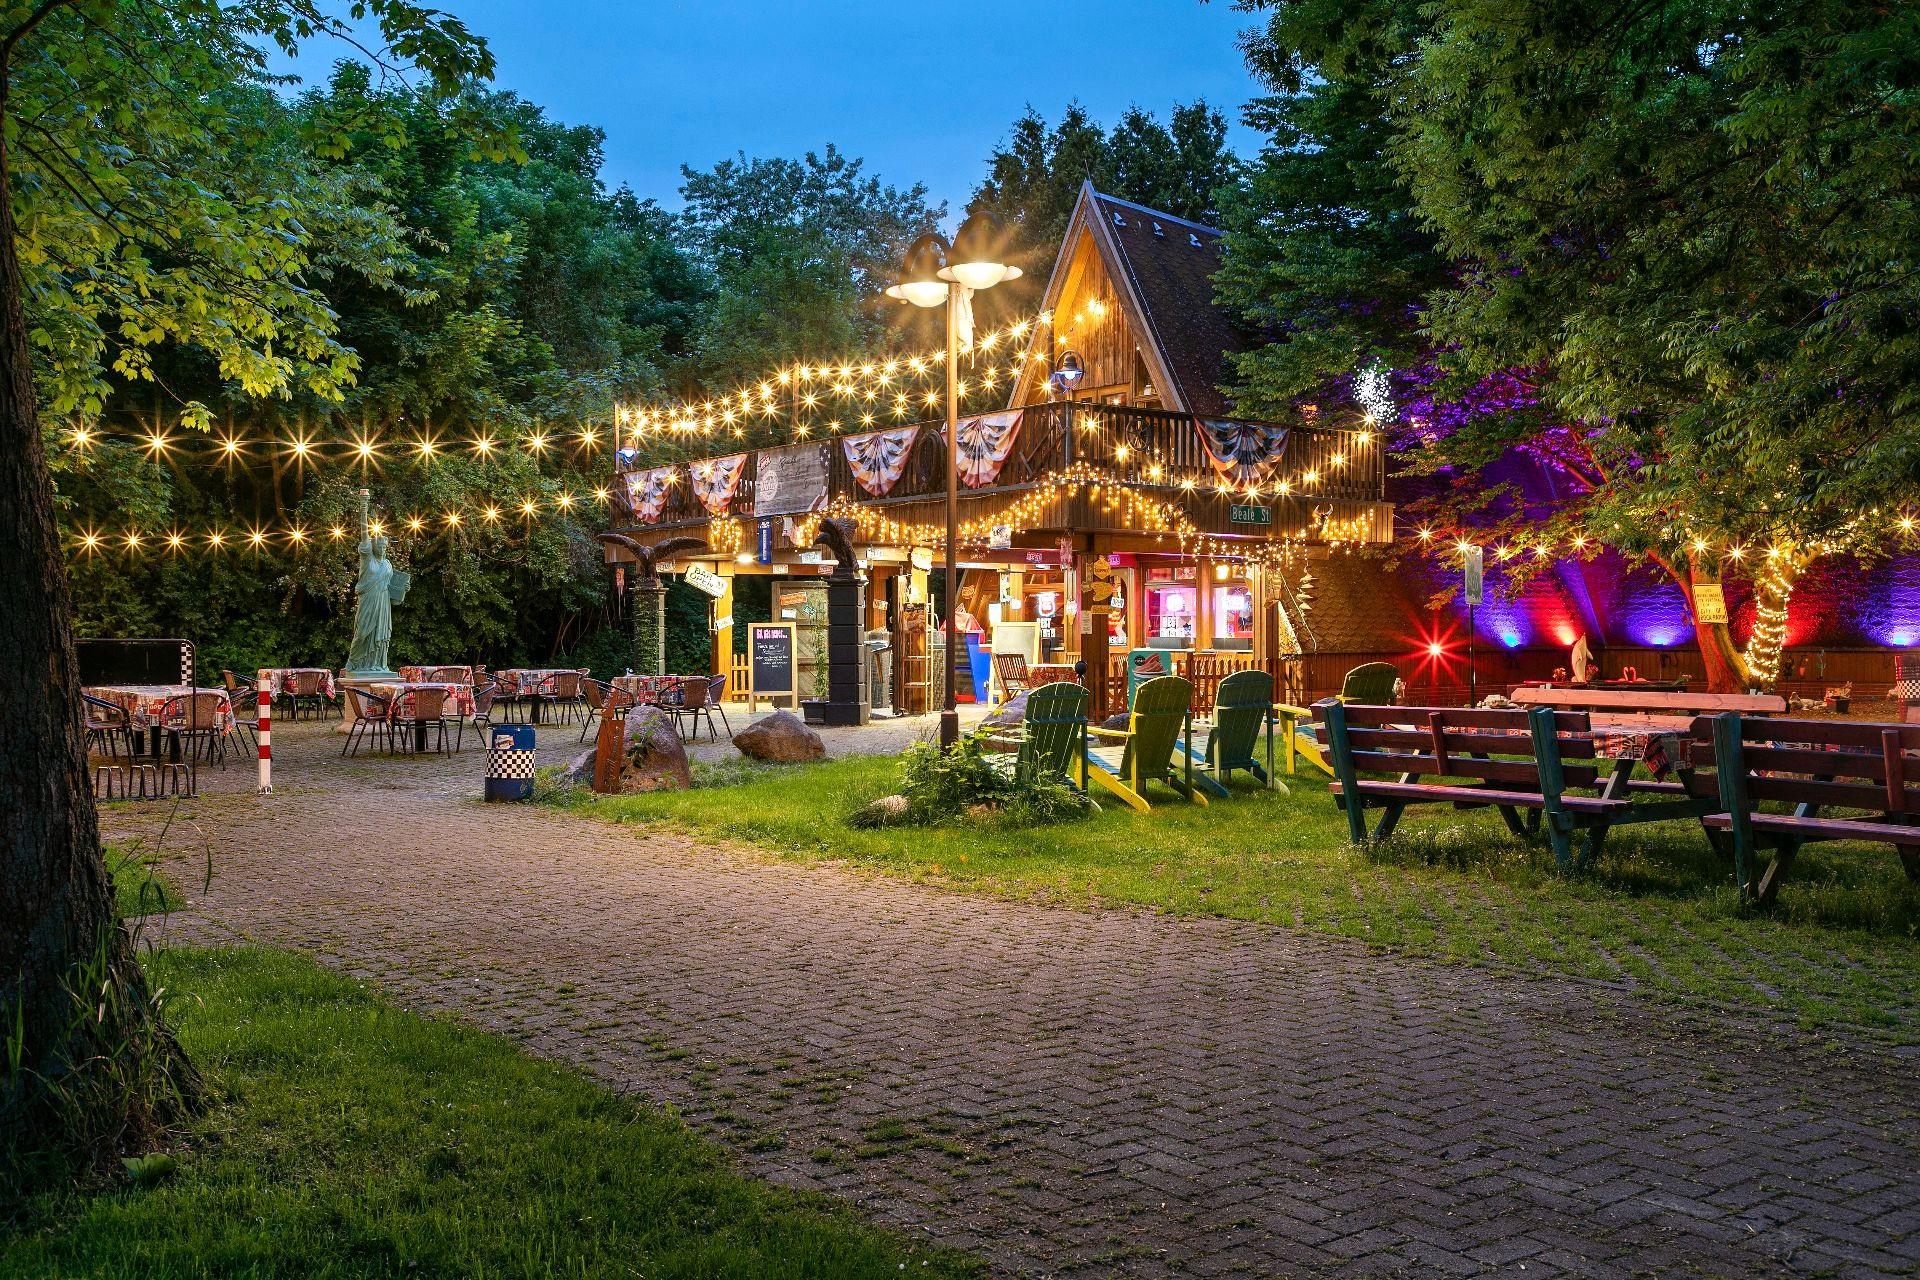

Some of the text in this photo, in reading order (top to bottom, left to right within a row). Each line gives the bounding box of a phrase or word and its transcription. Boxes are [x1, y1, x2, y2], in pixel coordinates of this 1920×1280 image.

[1232, 506, 1270, 522] Beale St
[689, 572, 714, 588] OPEN
[694, 567, 713, 581] BAR
